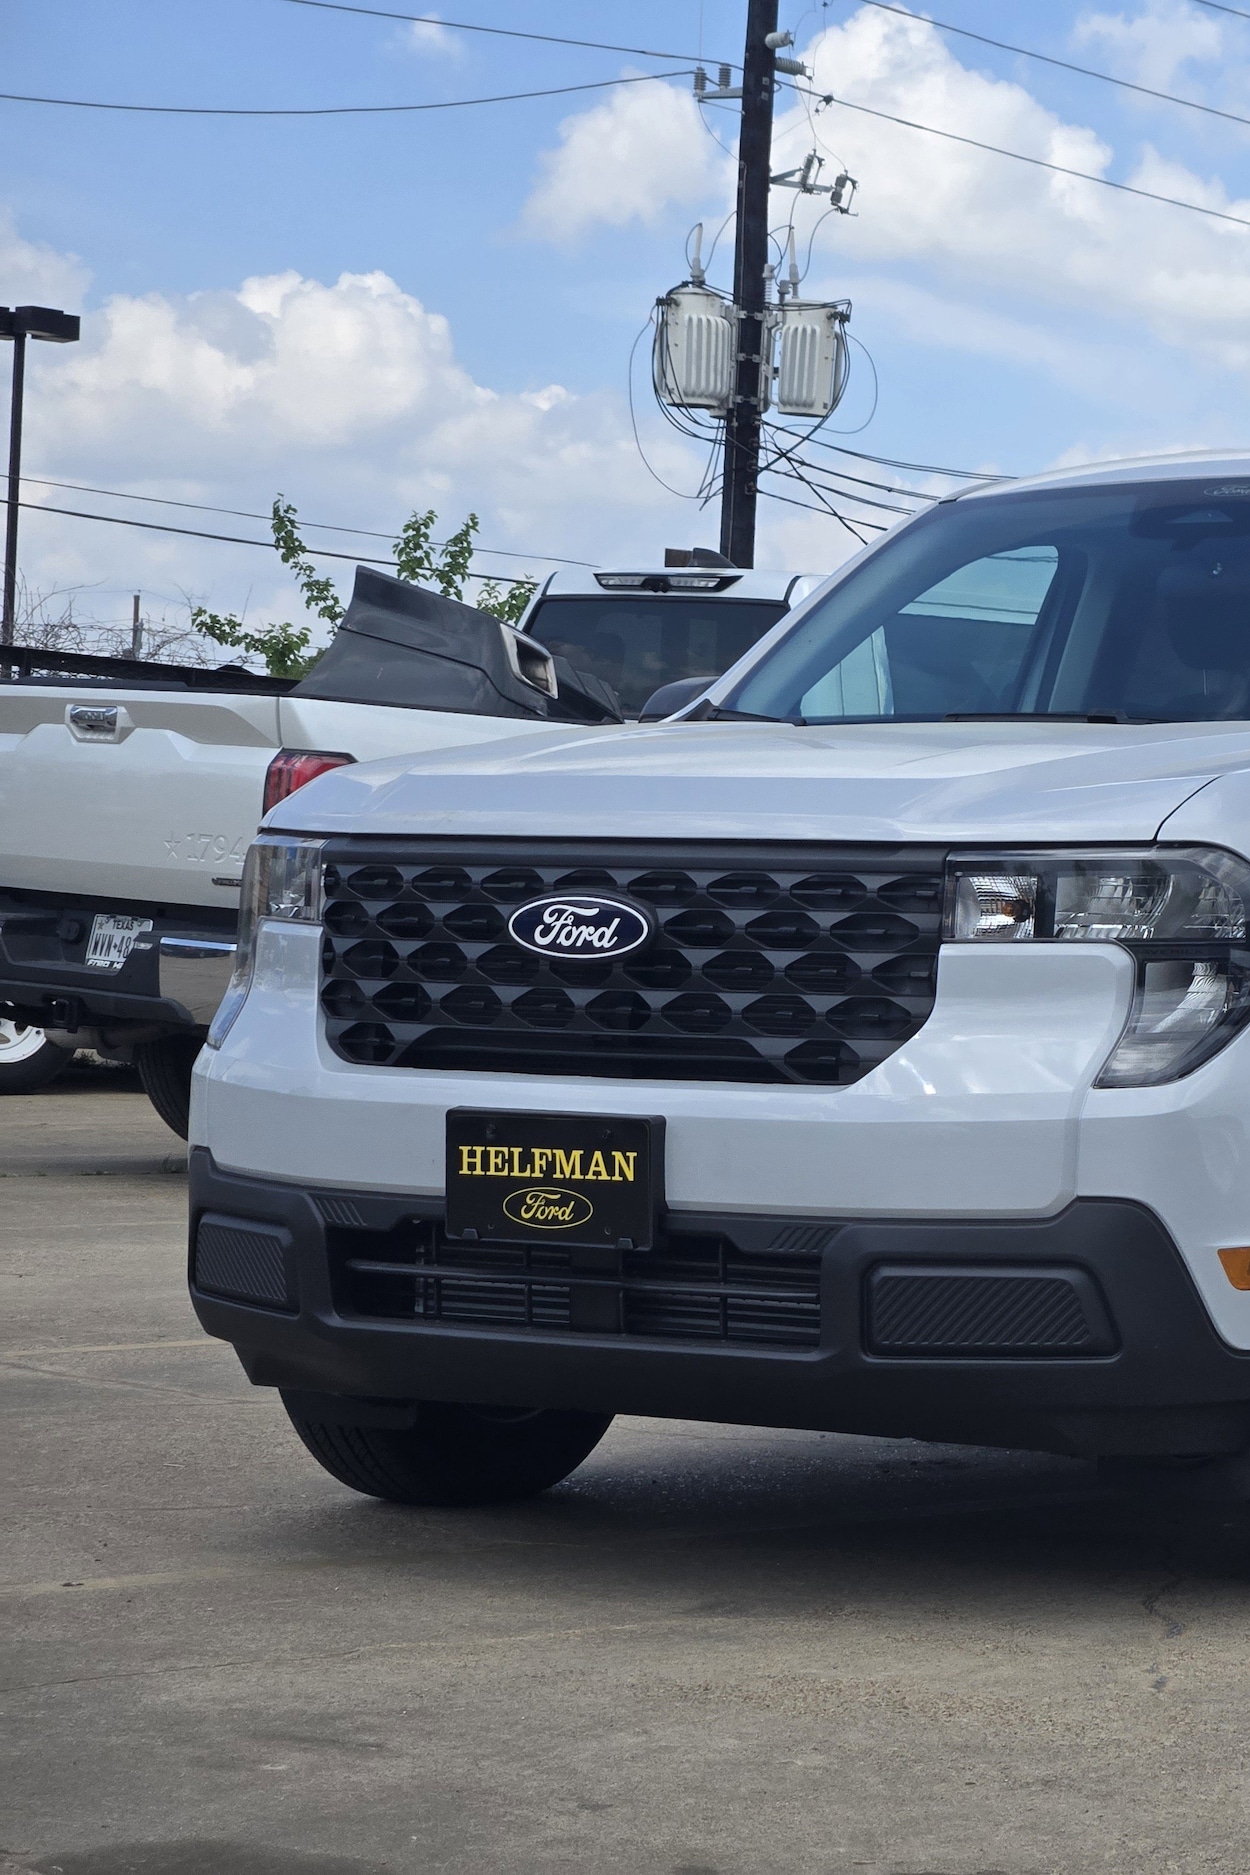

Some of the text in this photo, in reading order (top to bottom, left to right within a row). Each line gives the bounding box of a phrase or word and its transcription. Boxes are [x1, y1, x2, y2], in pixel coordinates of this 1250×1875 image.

[186, 833, 246, 866] 1794
[112, 919, 134, 931] TEXAS
[534, 904, 621, 948] Ford
[459, 1146, 637, 1181] HELFMAN
[521, 1192, 574, 1221] Ford
